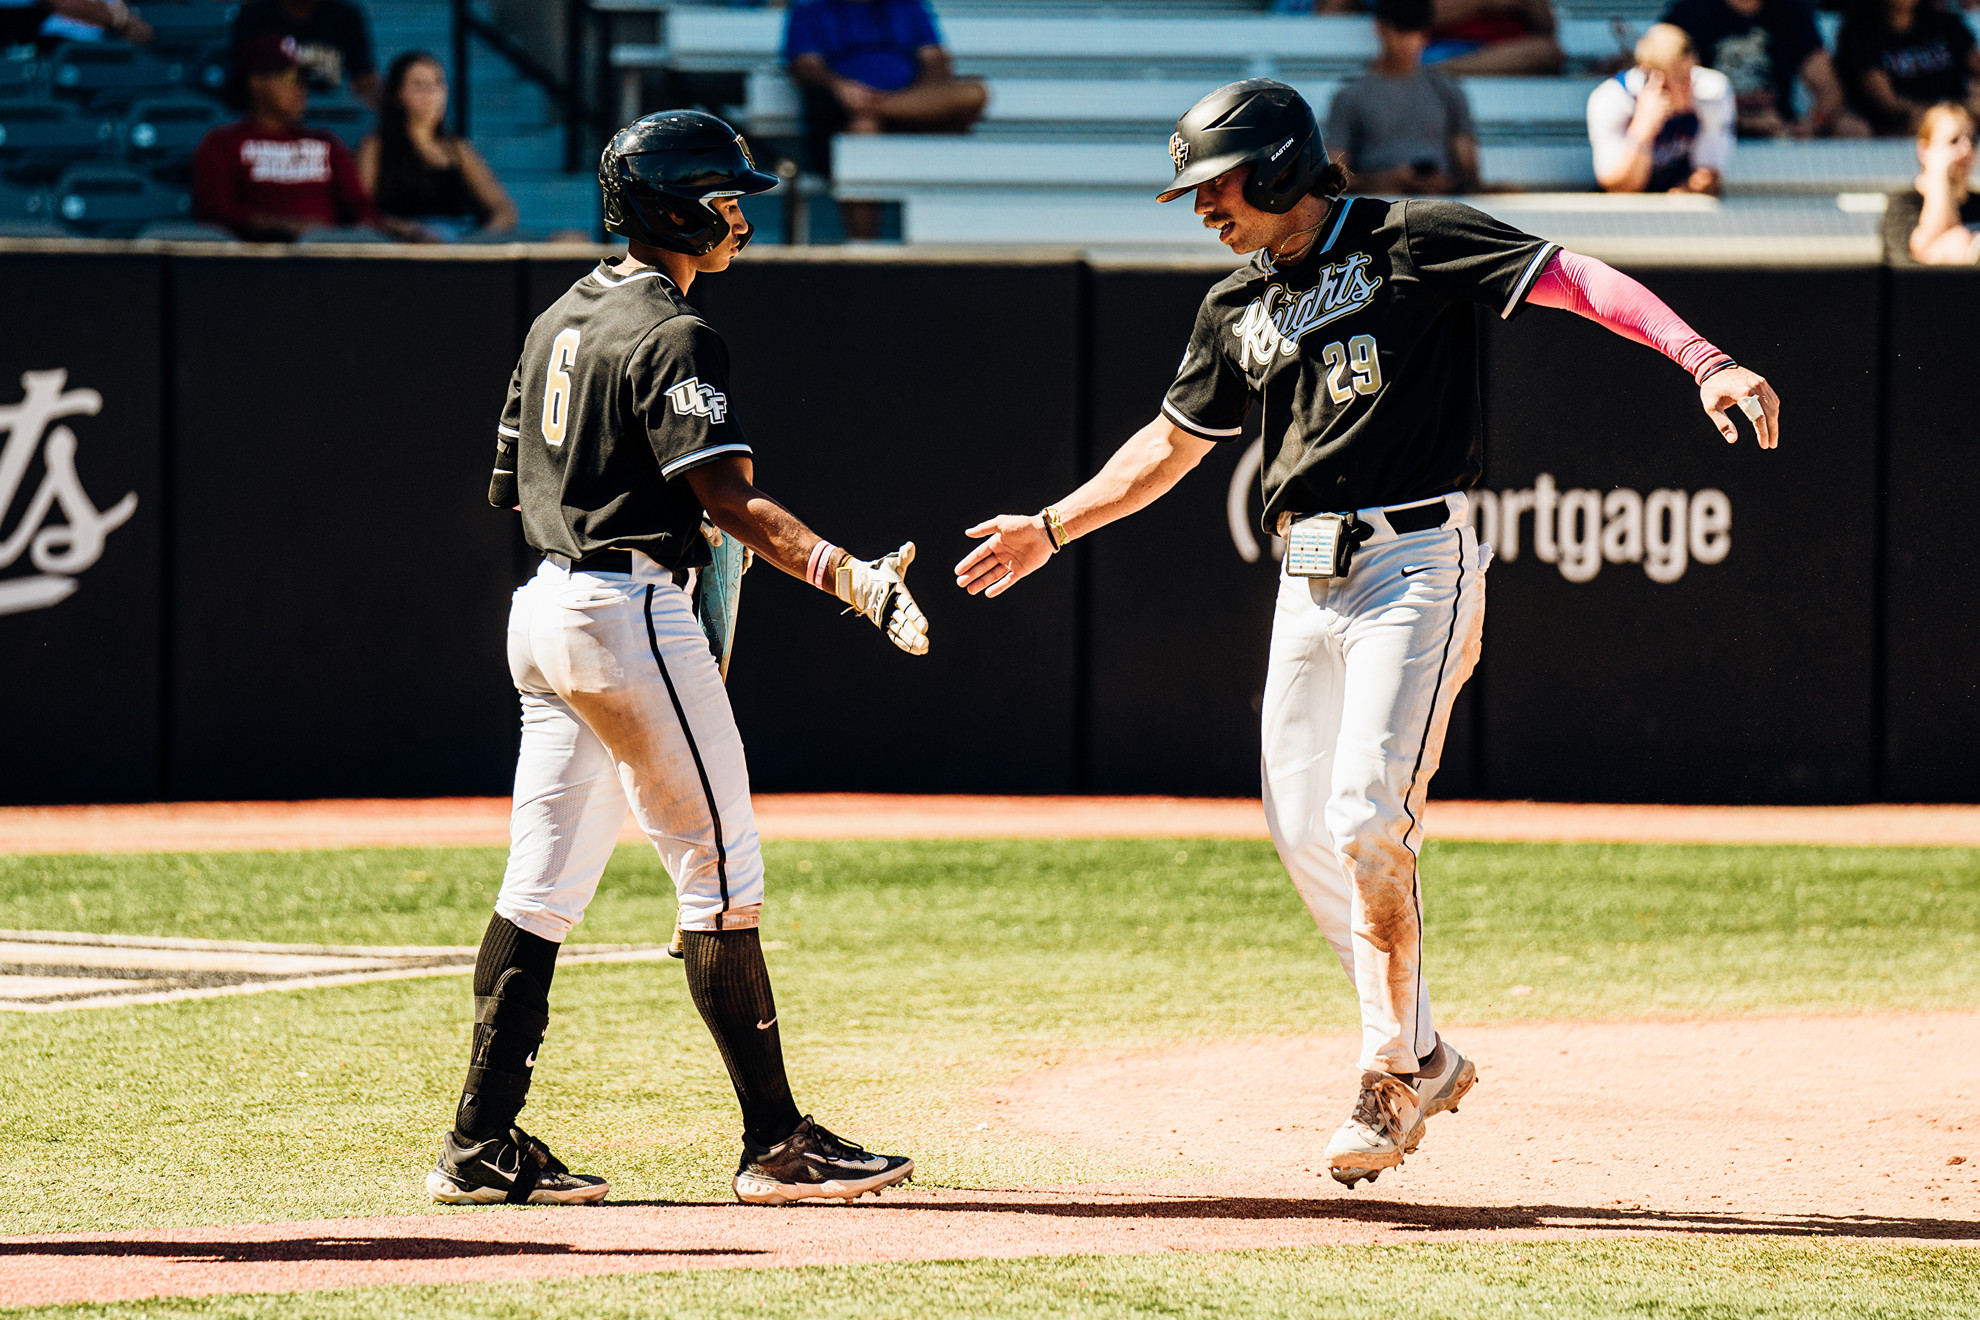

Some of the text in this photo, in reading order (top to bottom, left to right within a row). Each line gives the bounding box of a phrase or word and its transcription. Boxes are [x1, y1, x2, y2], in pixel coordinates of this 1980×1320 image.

[1270, 137, 1294, 162] EASTON
[1232, 252, 1382, 372] Knights
[541, 327, 581, 447] 6
[664, 376, 727, 424] UCF
[1322, 333, 1383, 405] 29
[1466, 472, 1732, 583] ortgage
